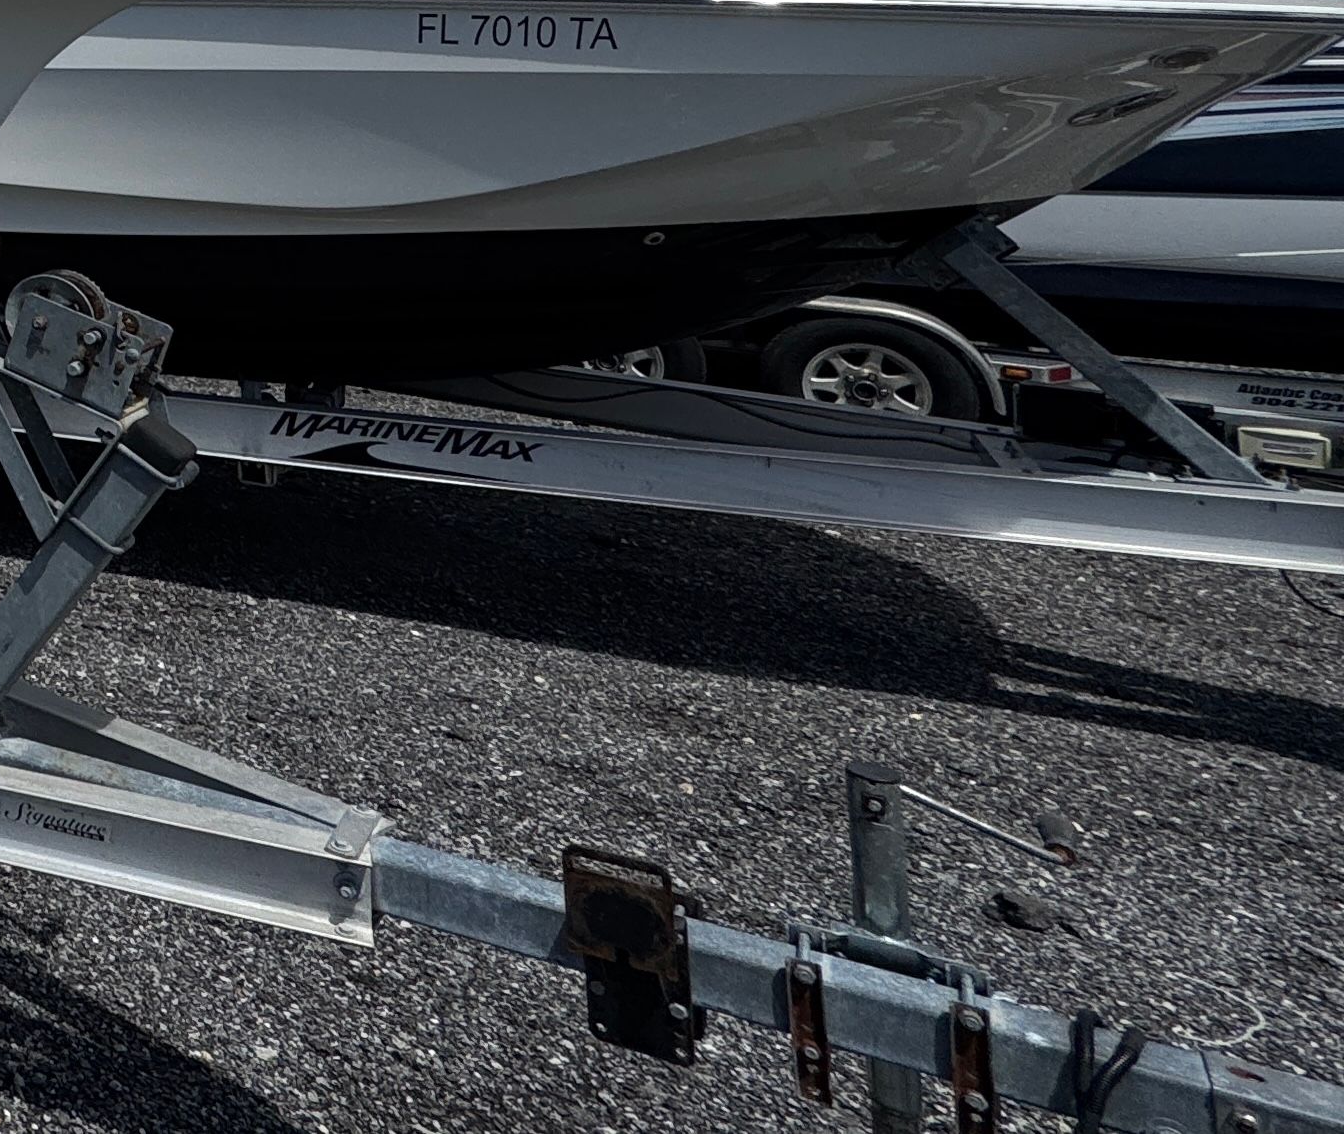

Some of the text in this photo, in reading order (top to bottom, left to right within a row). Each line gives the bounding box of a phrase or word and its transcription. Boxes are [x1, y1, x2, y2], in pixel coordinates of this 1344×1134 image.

[417, 14, 618, 50] FL 7010 TA
[1236, 383, 1305, 399] Atlantic
[4, 801, 107, 836] Signature
